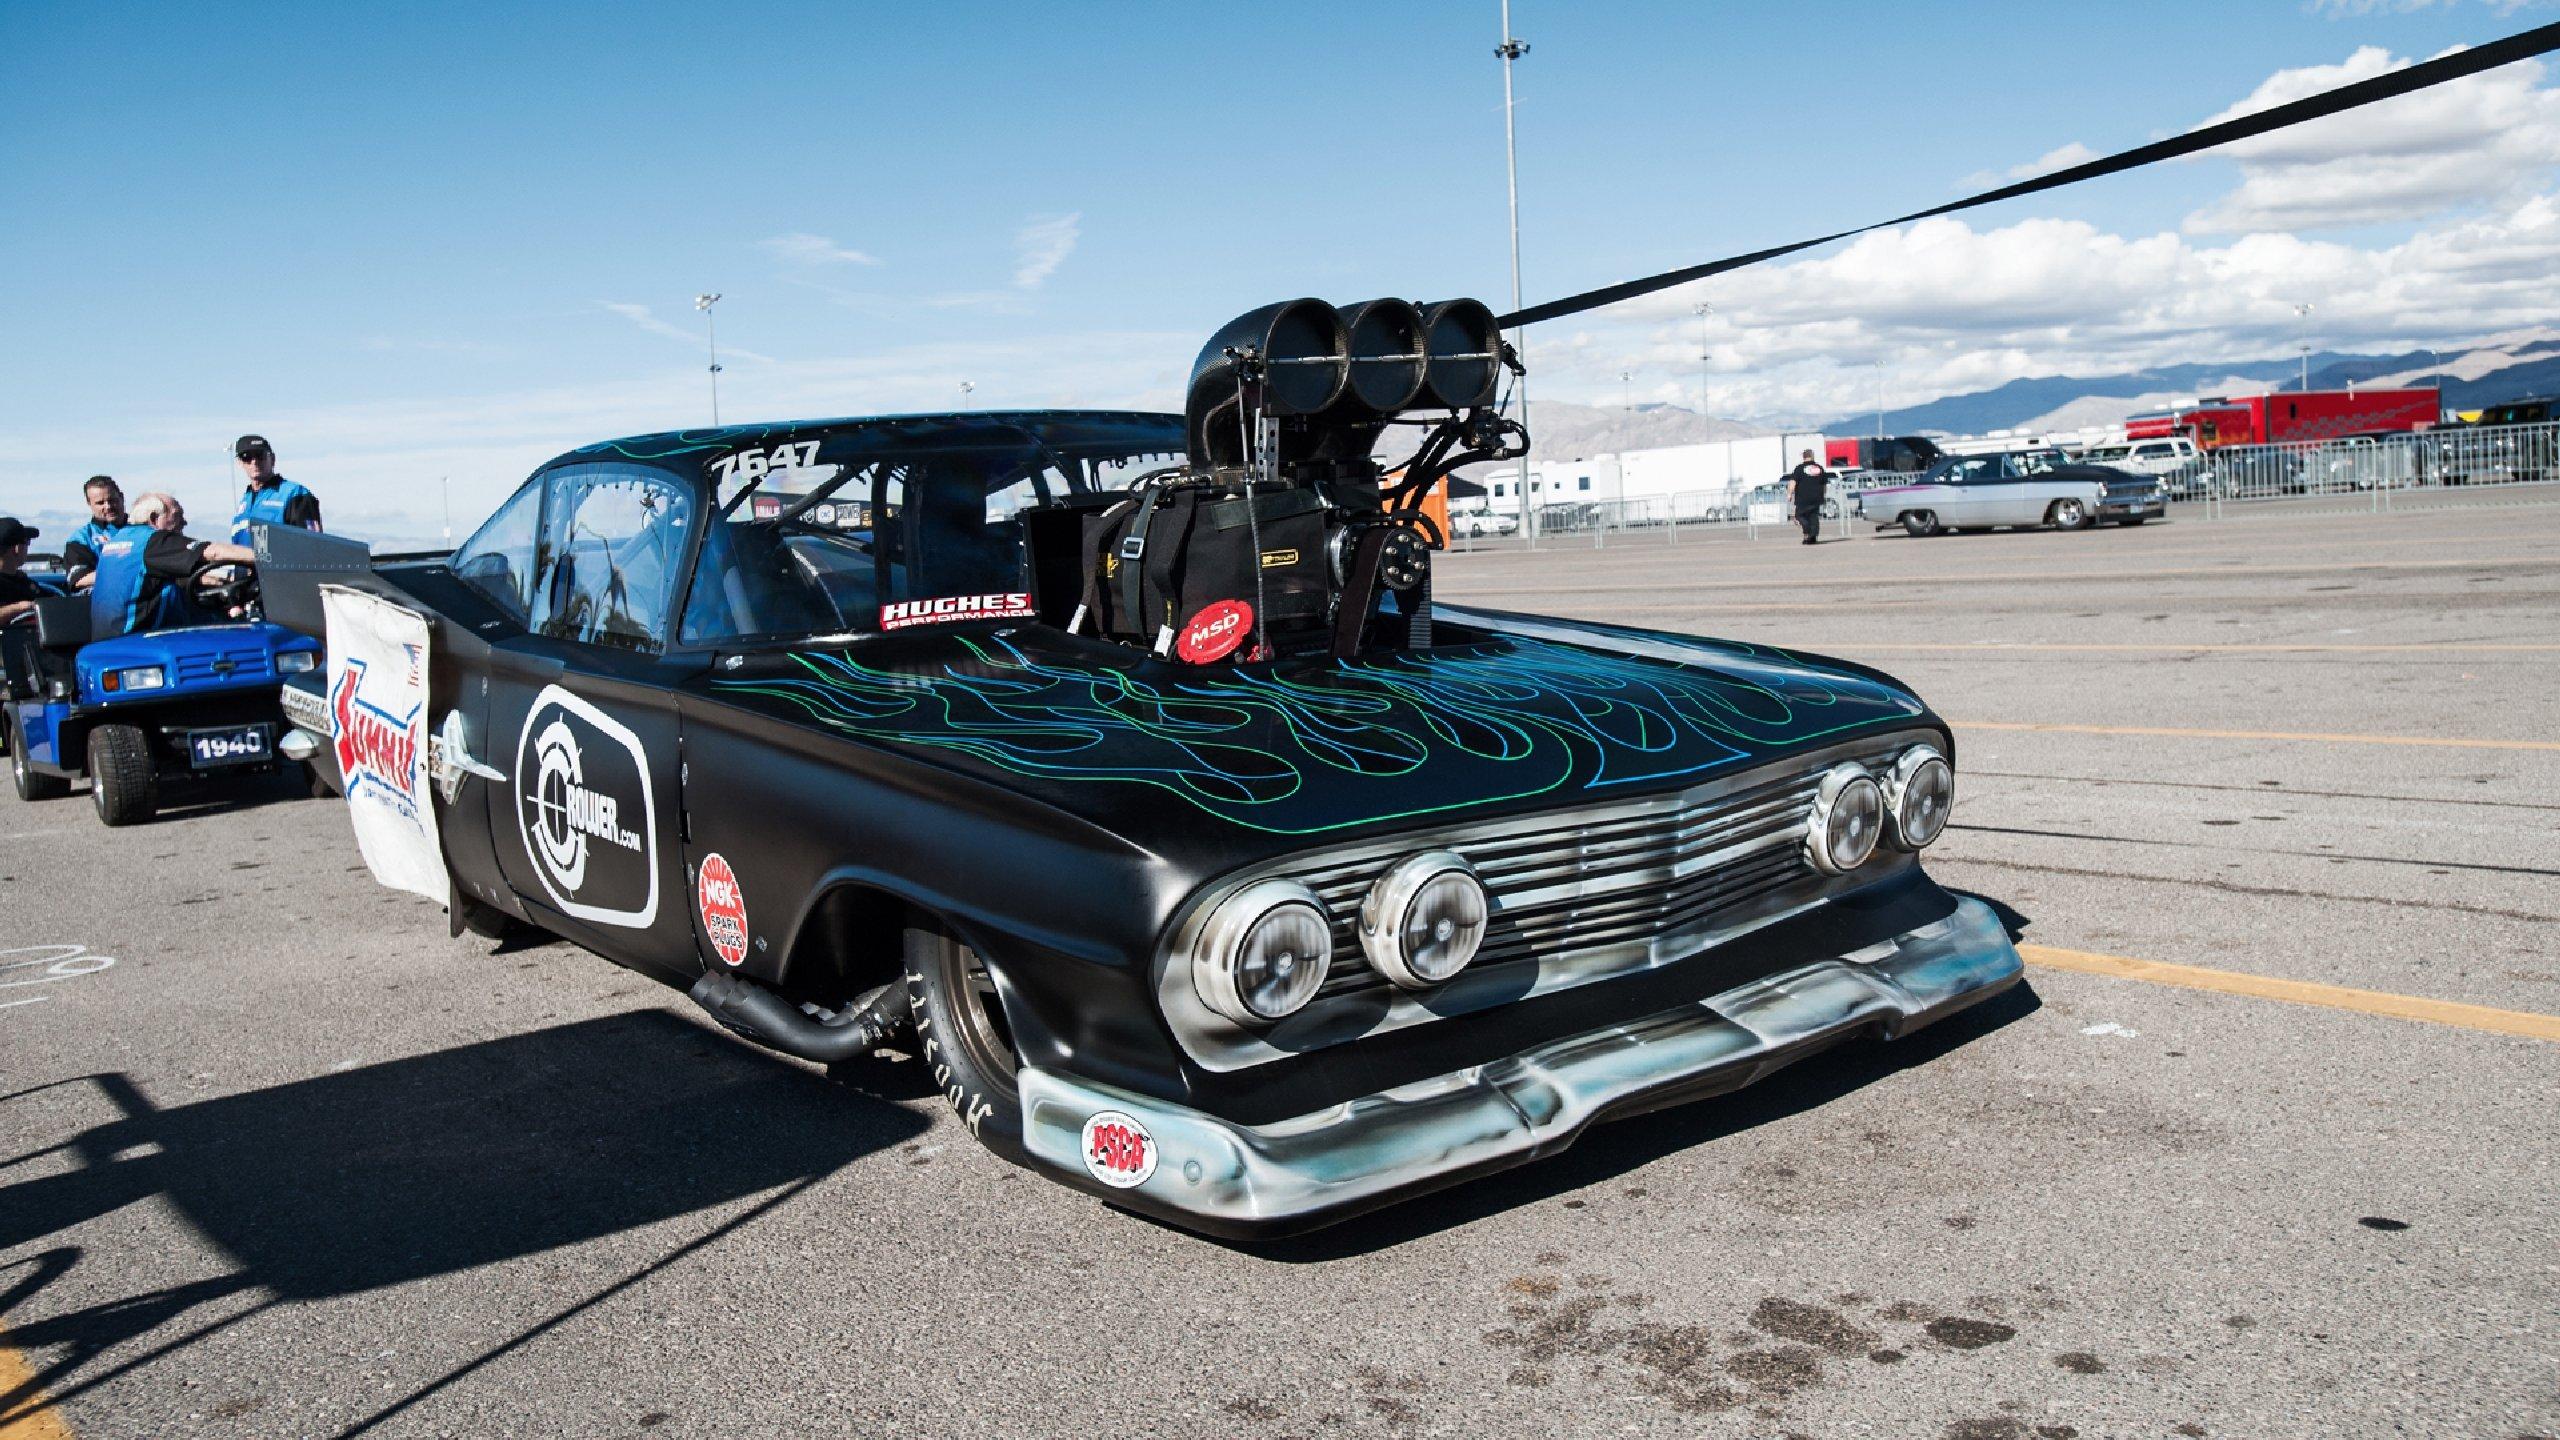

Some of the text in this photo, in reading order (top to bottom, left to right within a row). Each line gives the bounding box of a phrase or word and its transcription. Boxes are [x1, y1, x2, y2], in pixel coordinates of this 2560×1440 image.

[711, 440, 821, 486] 7647
[883, 593, 1028, 622] HUGHES
[886, 609, 1036, 630] PERFORMANCE
[1190, 612, 1240, 646] MSD
[197, 732, 261, 759] 1940
[338, 669, 416, 793] SUMMIT
[704, 879, 736, 909] NGK
[710, 915, 739, 932] SPARK
[714, 930, 743, 949] PLUGS
[1092, 1124, 1145, 1172] PSCA
